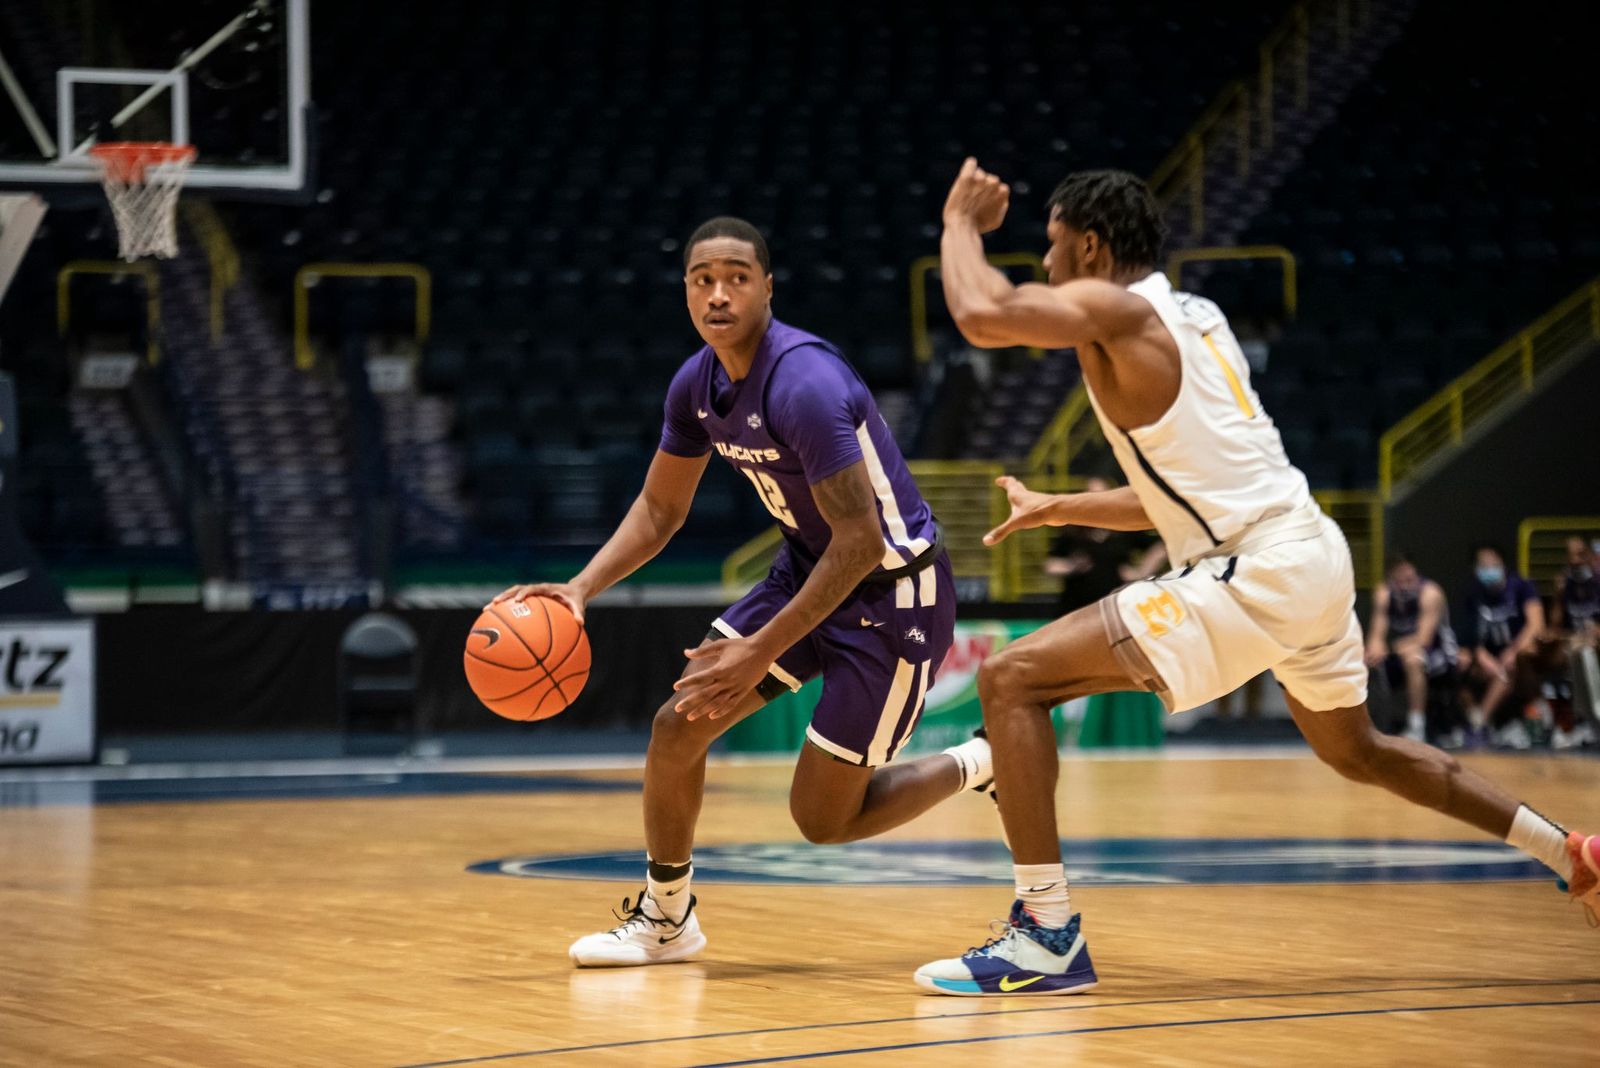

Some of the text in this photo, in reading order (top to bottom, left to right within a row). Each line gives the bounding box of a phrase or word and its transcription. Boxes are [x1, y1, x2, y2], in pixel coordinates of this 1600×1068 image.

[712, 442, 781, 463] ILCATS
[740, 467, 799, 530] 12
[0, 636, 70, 691] tz
